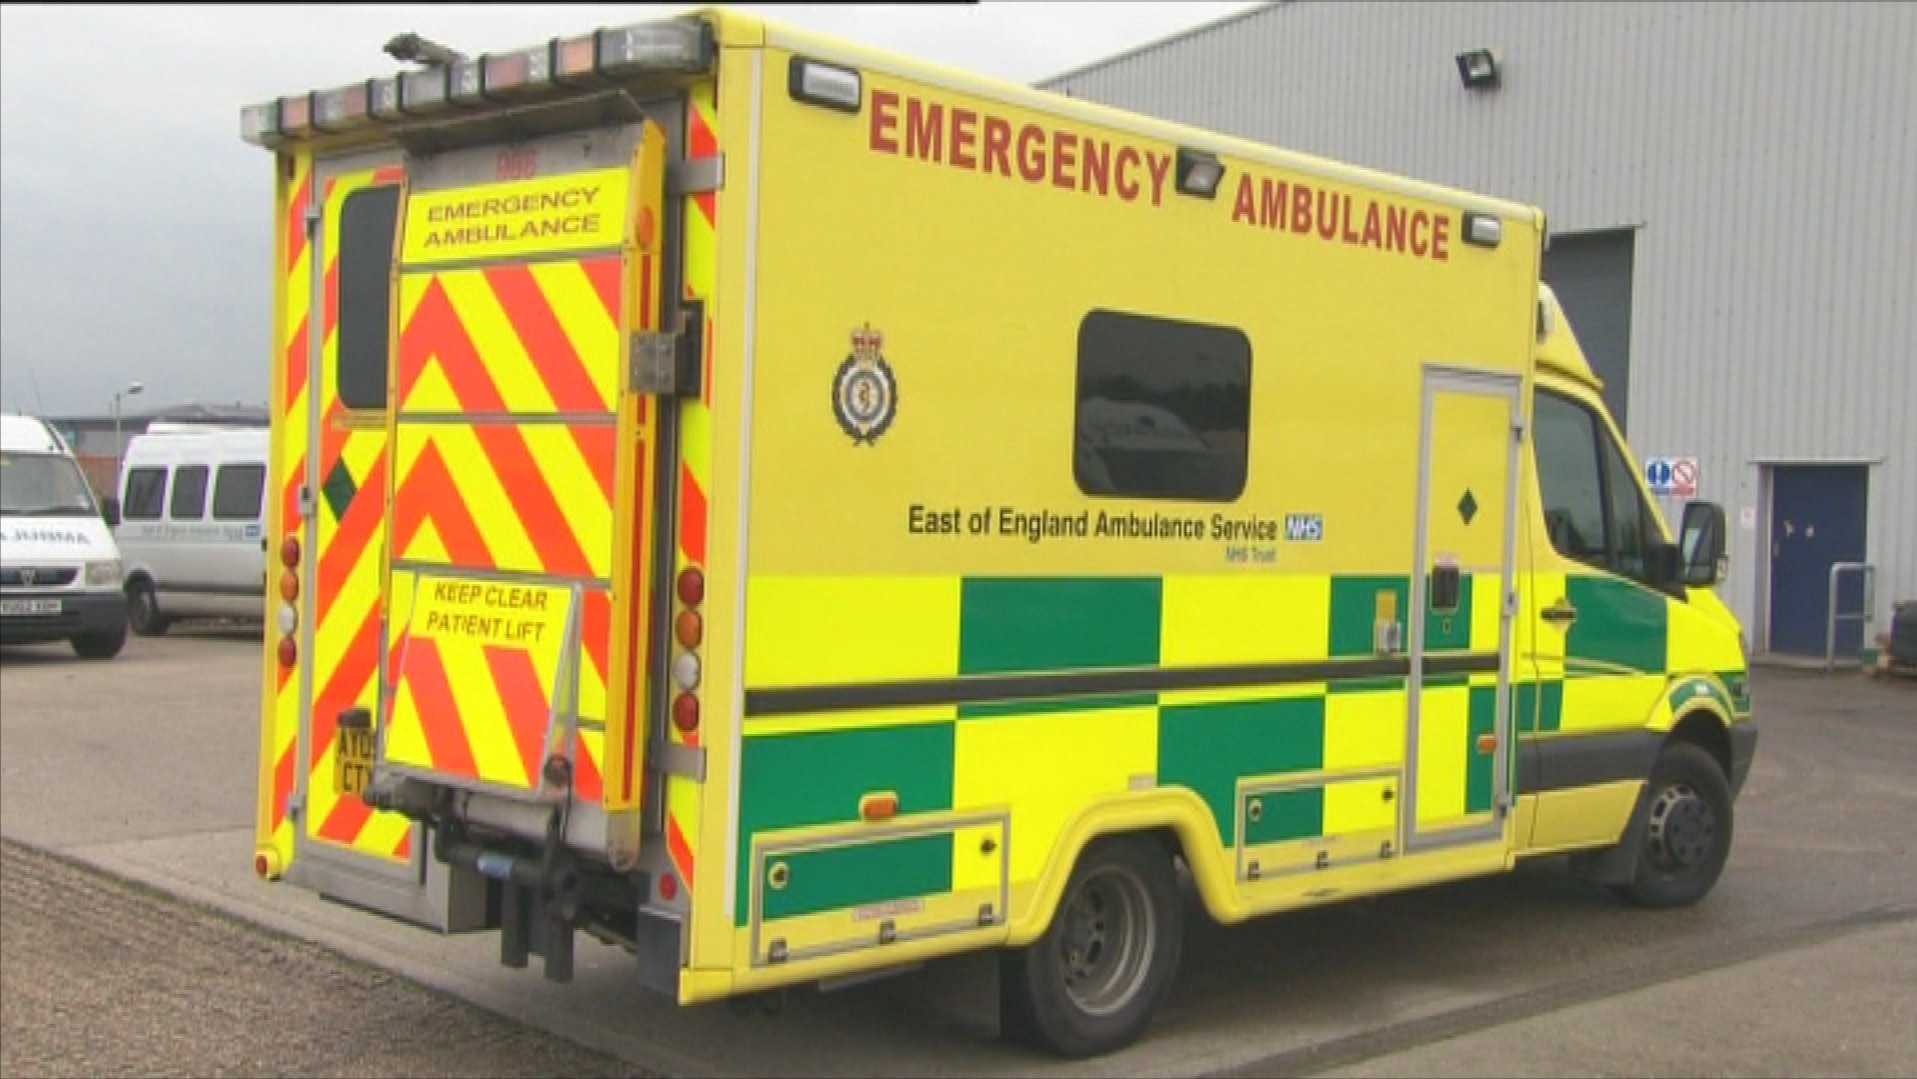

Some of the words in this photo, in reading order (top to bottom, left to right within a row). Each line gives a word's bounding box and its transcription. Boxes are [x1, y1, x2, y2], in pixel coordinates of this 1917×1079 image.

[868, 88, 1171, 207] EMERGENCY
[1231, 172, 1450, 262] AMBULANCE
[427, 187, 600, 222] EMERGENCY
[424, 213, 601, 248] AMBULANCE
[908, 504, 960, 535] East
[968, 507, 991, 535] of
[999, 507, 1089, 544] England
[1094, 510, 1204, 540] Ambulance
[1211, 512, 1277, 541] Service
[1285, 514, 1322, 541] NHS
[433, 581, 482, 605] KEEP
[484, 587, 548, 611] CLEAR
[427, 611, 502, 639] PATIENT
[505, 620, 546, 643] LIFT
